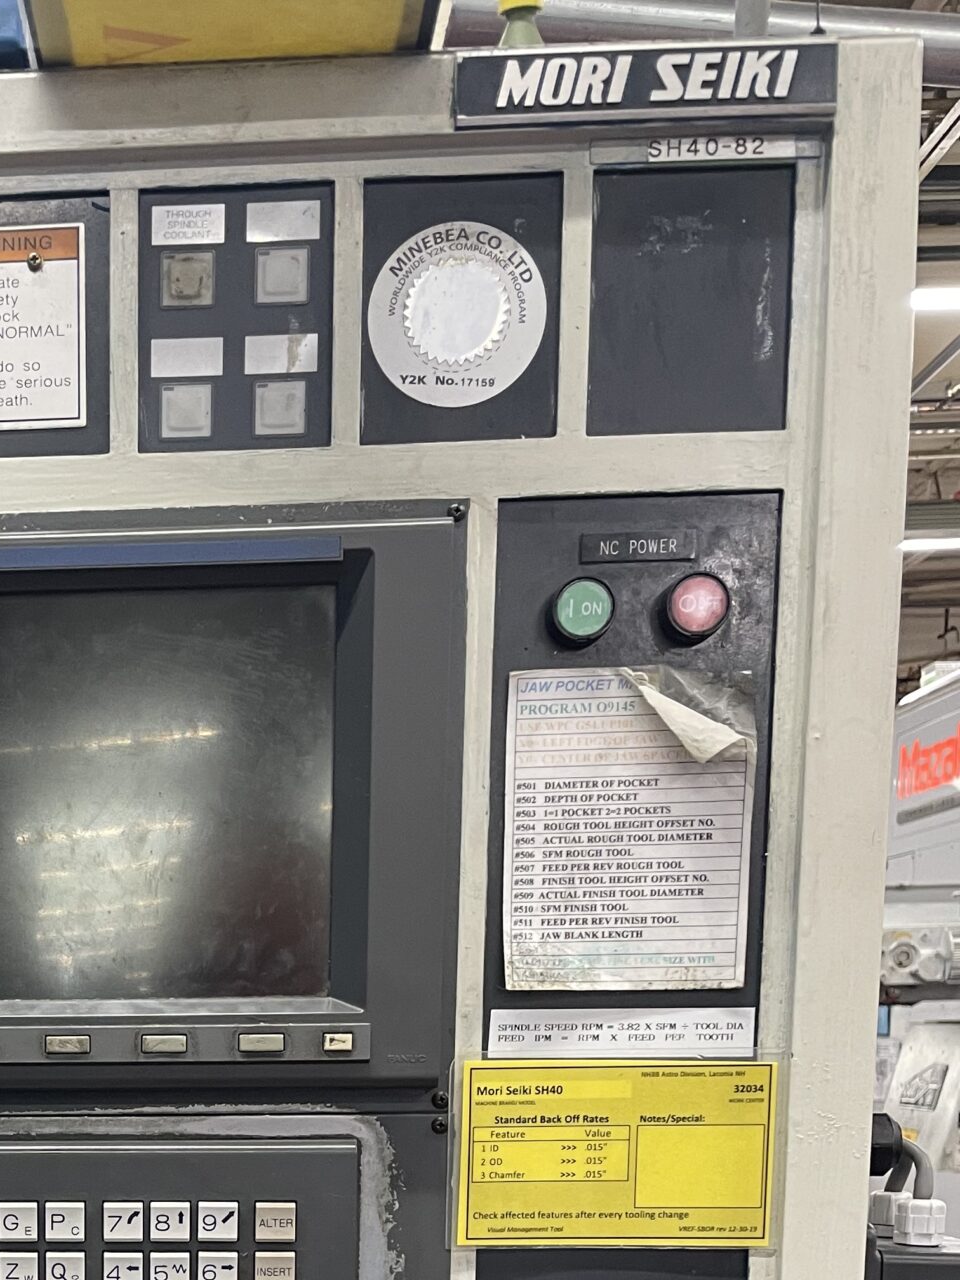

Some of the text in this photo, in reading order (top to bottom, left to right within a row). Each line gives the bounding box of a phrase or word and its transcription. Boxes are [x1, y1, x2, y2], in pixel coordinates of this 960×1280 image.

[496, 49, 798, 108] MORI SEIKI
[649, 137, 765, 158] SH40-82
[166, 210, 211, 218] THROUGH
[163, 230, 210, 240] COOLANT
[389, 228, 533, 283] MINEBEA CO. LTD
[24, 362, 40, 371] so
[16, 376, 71, 388] serious
[400, 375, 495, 387] Y2K No. 17159
[600, 538, 677, 556] NC POWER
[582, 601, 602, 616] ON
[521, 679, 614, 693] JAW POCKET
[520, 703, 591, 715] PROGRAM
[897, 718, 960, 800] Maza
[544, 780, 598, 790] DIAMETER
[601, 779, 616, 788] OF
[618, 778, 660, 787] POCKET
[544, 794, 577, 803] DEPTH
[580, 793, 594, 802] OF
[597, 792, 639, 801] POCKET
[477, 1085, 563, 1095] Mori Seiki SH40
[734, 1085, 764, 1093] 32034
[495, 1115, 609, 1124] Standard Back Off Rates
[640, 1114, 705, 1123] Notes/Special:
[491, 1129, 611, 1138] Feature Value
[473, 1210, 689, 1220] Check affected features after every tooling change
[259, 1218, 293, 1228] ALTER
[257, 1267, 292, 1277] INSERT
